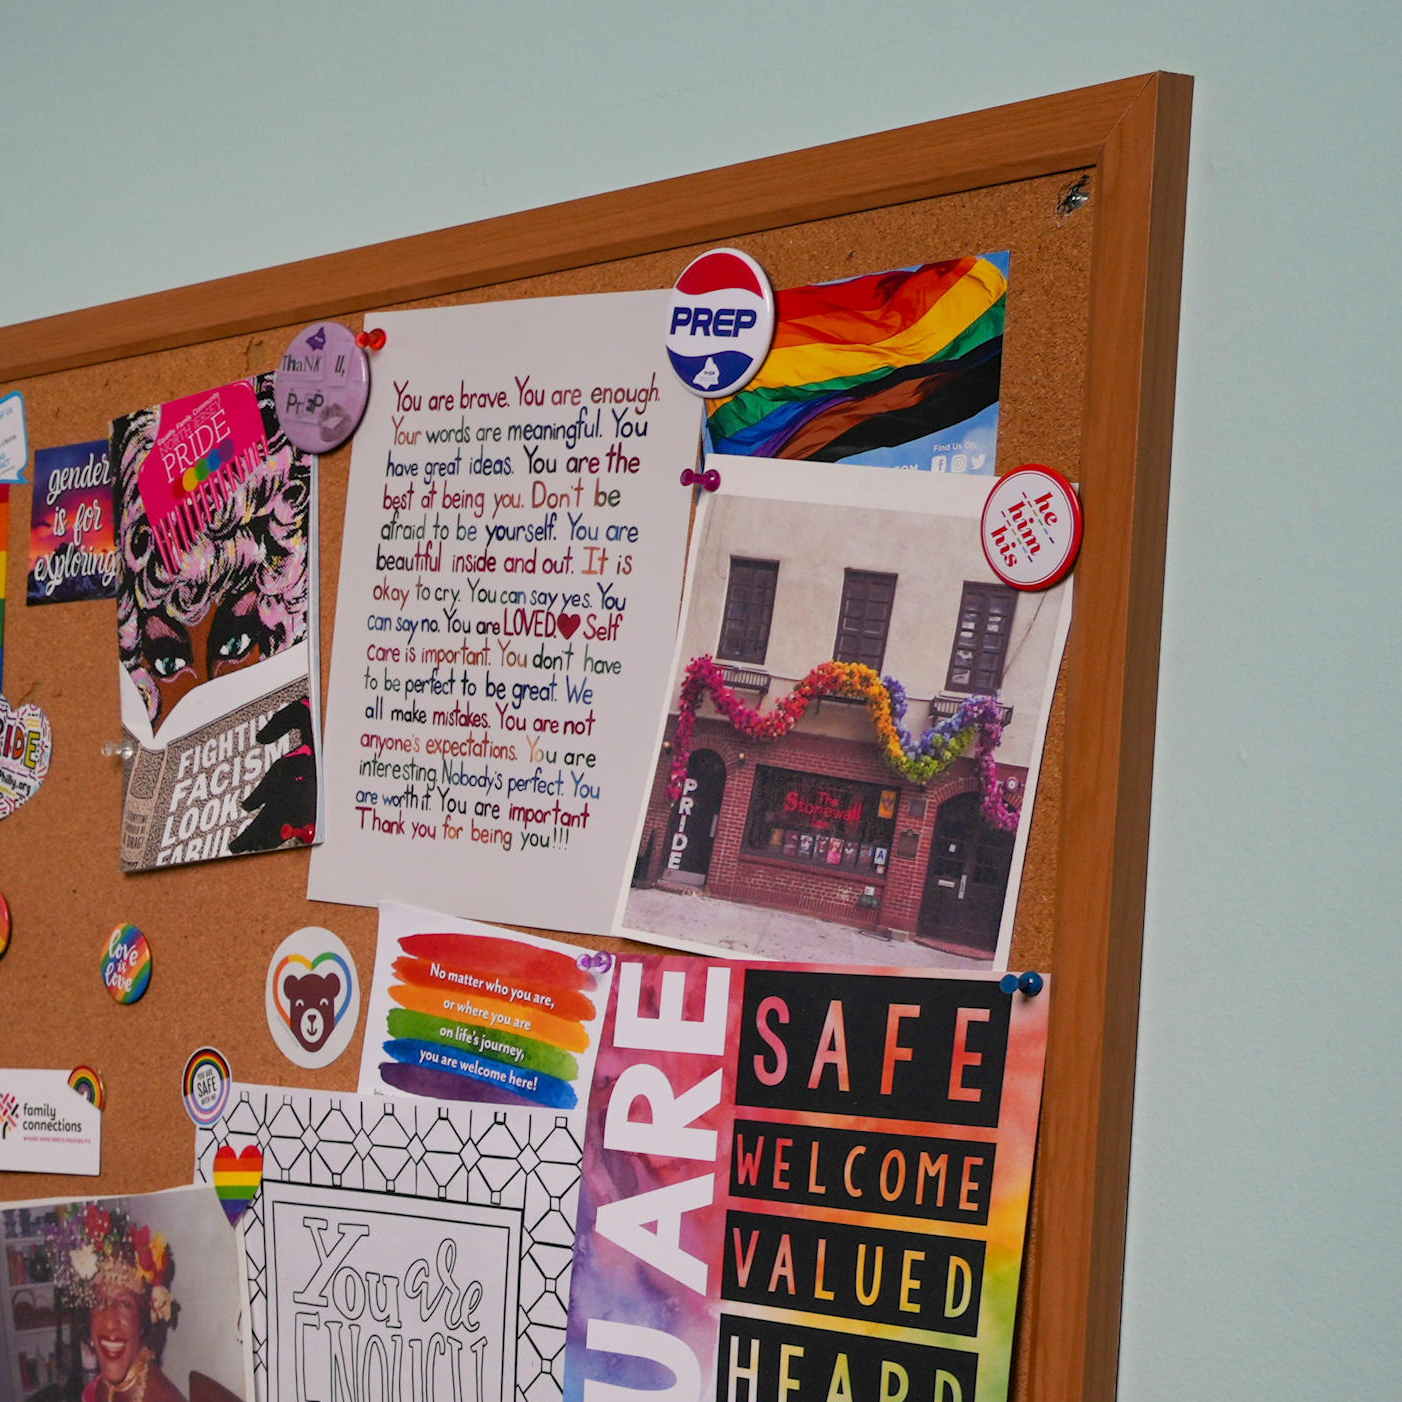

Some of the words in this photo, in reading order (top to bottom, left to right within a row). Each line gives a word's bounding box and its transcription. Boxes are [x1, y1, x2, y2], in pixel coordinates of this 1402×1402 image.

[670, 306, 757, 338] PREP
[393, 379, 421, 412] You
[428, 394, 454, 412] are
[460, 379, 511, 410] brave.
[514, 375, 545, 406] You
[551, 388, 582, 406] are
[590, 372, 660, 415] enough.
[161, 409, 232, 484] PRIDE
[391, 415, 422, 446] Your
[426, 415, 471, 444] words
[476, 424, 501, 442] are
[507, 406, 602, 450] meaningful.
[612, 407, 648, 440] You
[933, 444, 950, 452] Find
[47, 453, 112, 505] gender
[53, 505, 68, 536] is
[74, 499, 102, 547] for
[1006, 499, 1044, 558] him
[1033, 490, 1060, 528] he
[988, 526, 1018, 569] his
[34, 544, 116, 596] exploring
[784, 791, 863, 822] Stonewall
[819, 791, 840, 806] The
[355, 805, 405, 835] Thank
[412, 821, 436, 840] you
[442, 815, 463, 840] for
[471, 818, 512, 851] being
[520, 827, 569, 850] you!!!
[109, 929, 138, 966] love
[117, 960, 126, 972] is
[105, 962, 132, 992] love
[430, 962, 446, 980] No
[448, 972, 484, 990] matter
[486, 977, 509, 995] who
[510, 986, 531, 1002] you
[533, 994, 555, 1009] are,
[443, 999, 455, 1010] or
[457, 1001, 489, 1020] where
[490, 1011, 511, 1026] you
[513, 1017, 531, 1030] are
[439, 1027, 454, 1038] on
[455, 1028, 479, 1046] life's
[479, 1034, 525, 1062] journey,
[752, 994, 992, 1103] SAFE
[197, 1079, 218, 1098] SAFE
[419, 1049, 440, 1064] you
[441, 1054, 458, 1069] are
[459, 1056, 507, 1081] welcome
[508, 1070, 538, 1091] here!
[22, 1119, 81, 1132] connections
[23, 1103, 56, 1121] family
[594, 961, 734, 1299] ARE
[735, 1132, 985, 1211] WELCOME
[293, 1216, 402, 1328] You
[403, 1238, 484, 1332] are
[732, 1226, 973, 1320] VALUED
